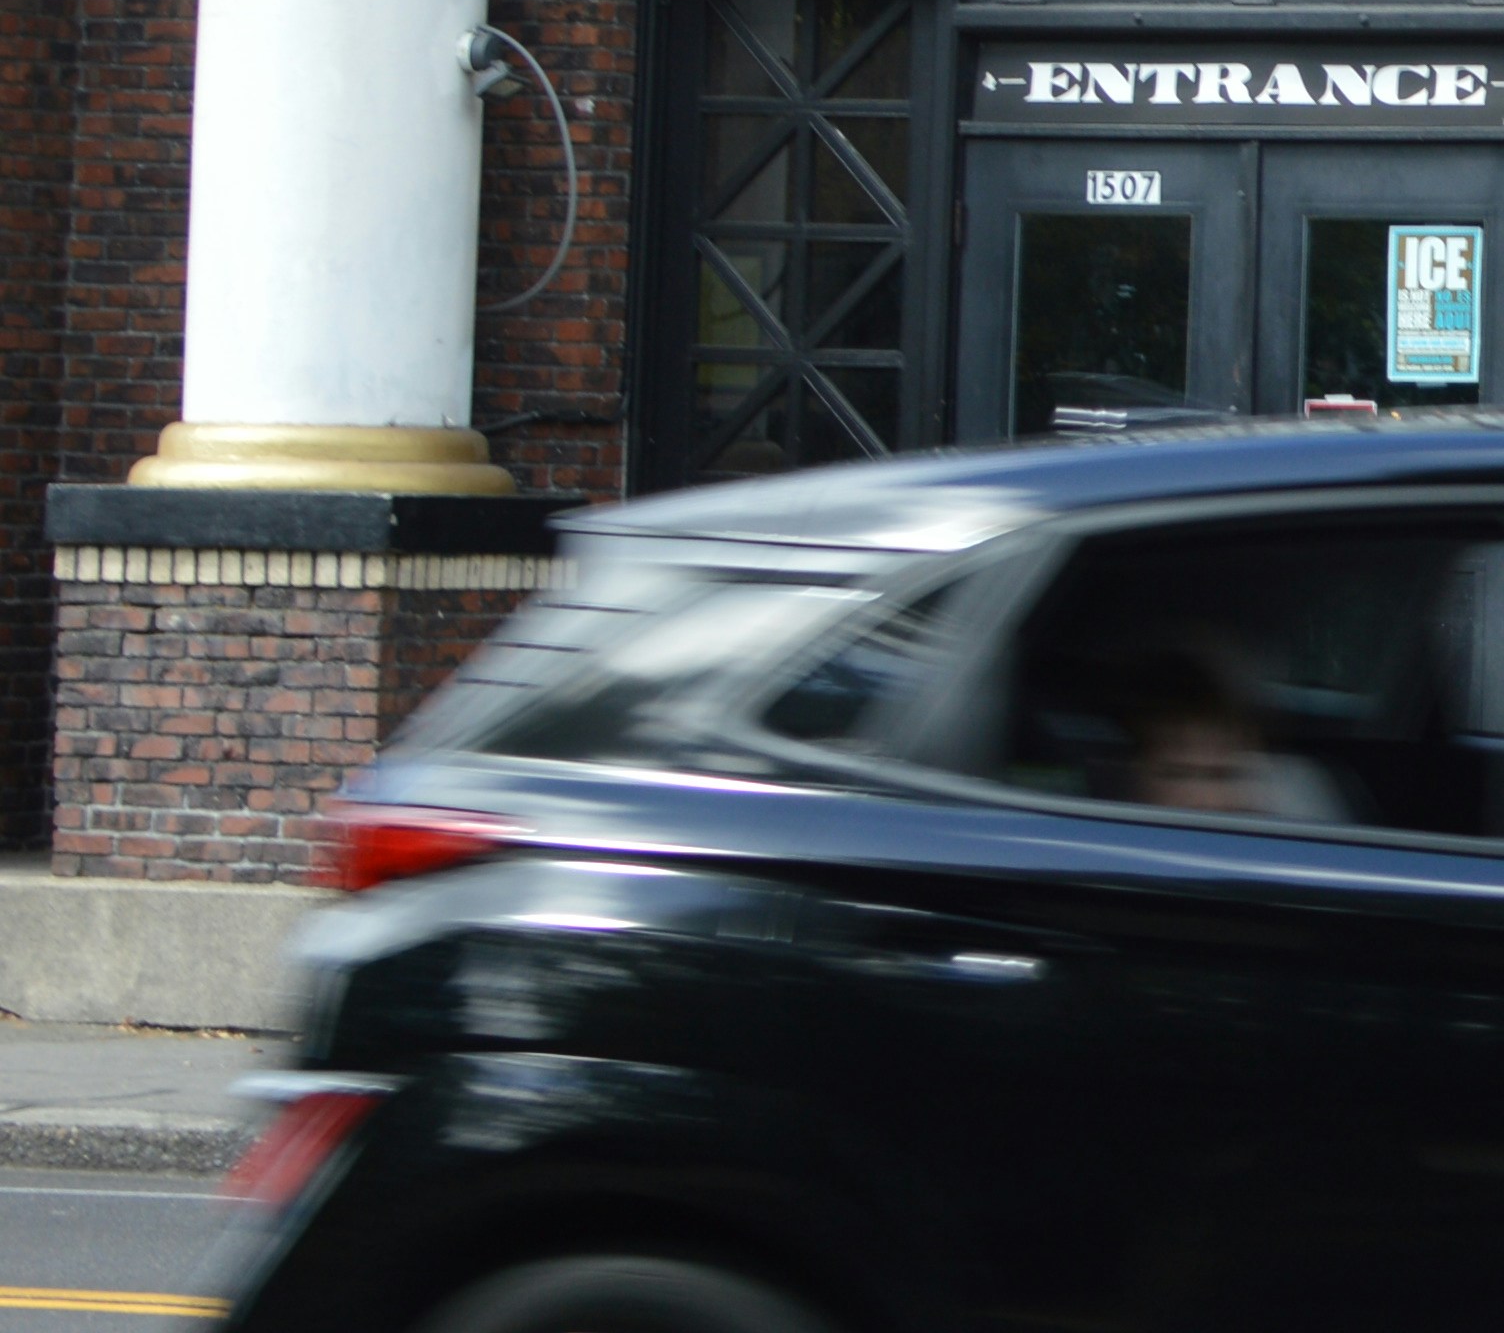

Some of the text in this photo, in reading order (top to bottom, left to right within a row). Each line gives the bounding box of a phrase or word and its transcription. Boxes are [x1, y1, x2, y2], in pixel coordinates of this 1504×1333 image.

[1025, 63, 1487, 105] ENTRANCE
[1090, 174, 1155, 201] 1507
[1404, 236, 1469, 290] ICE
